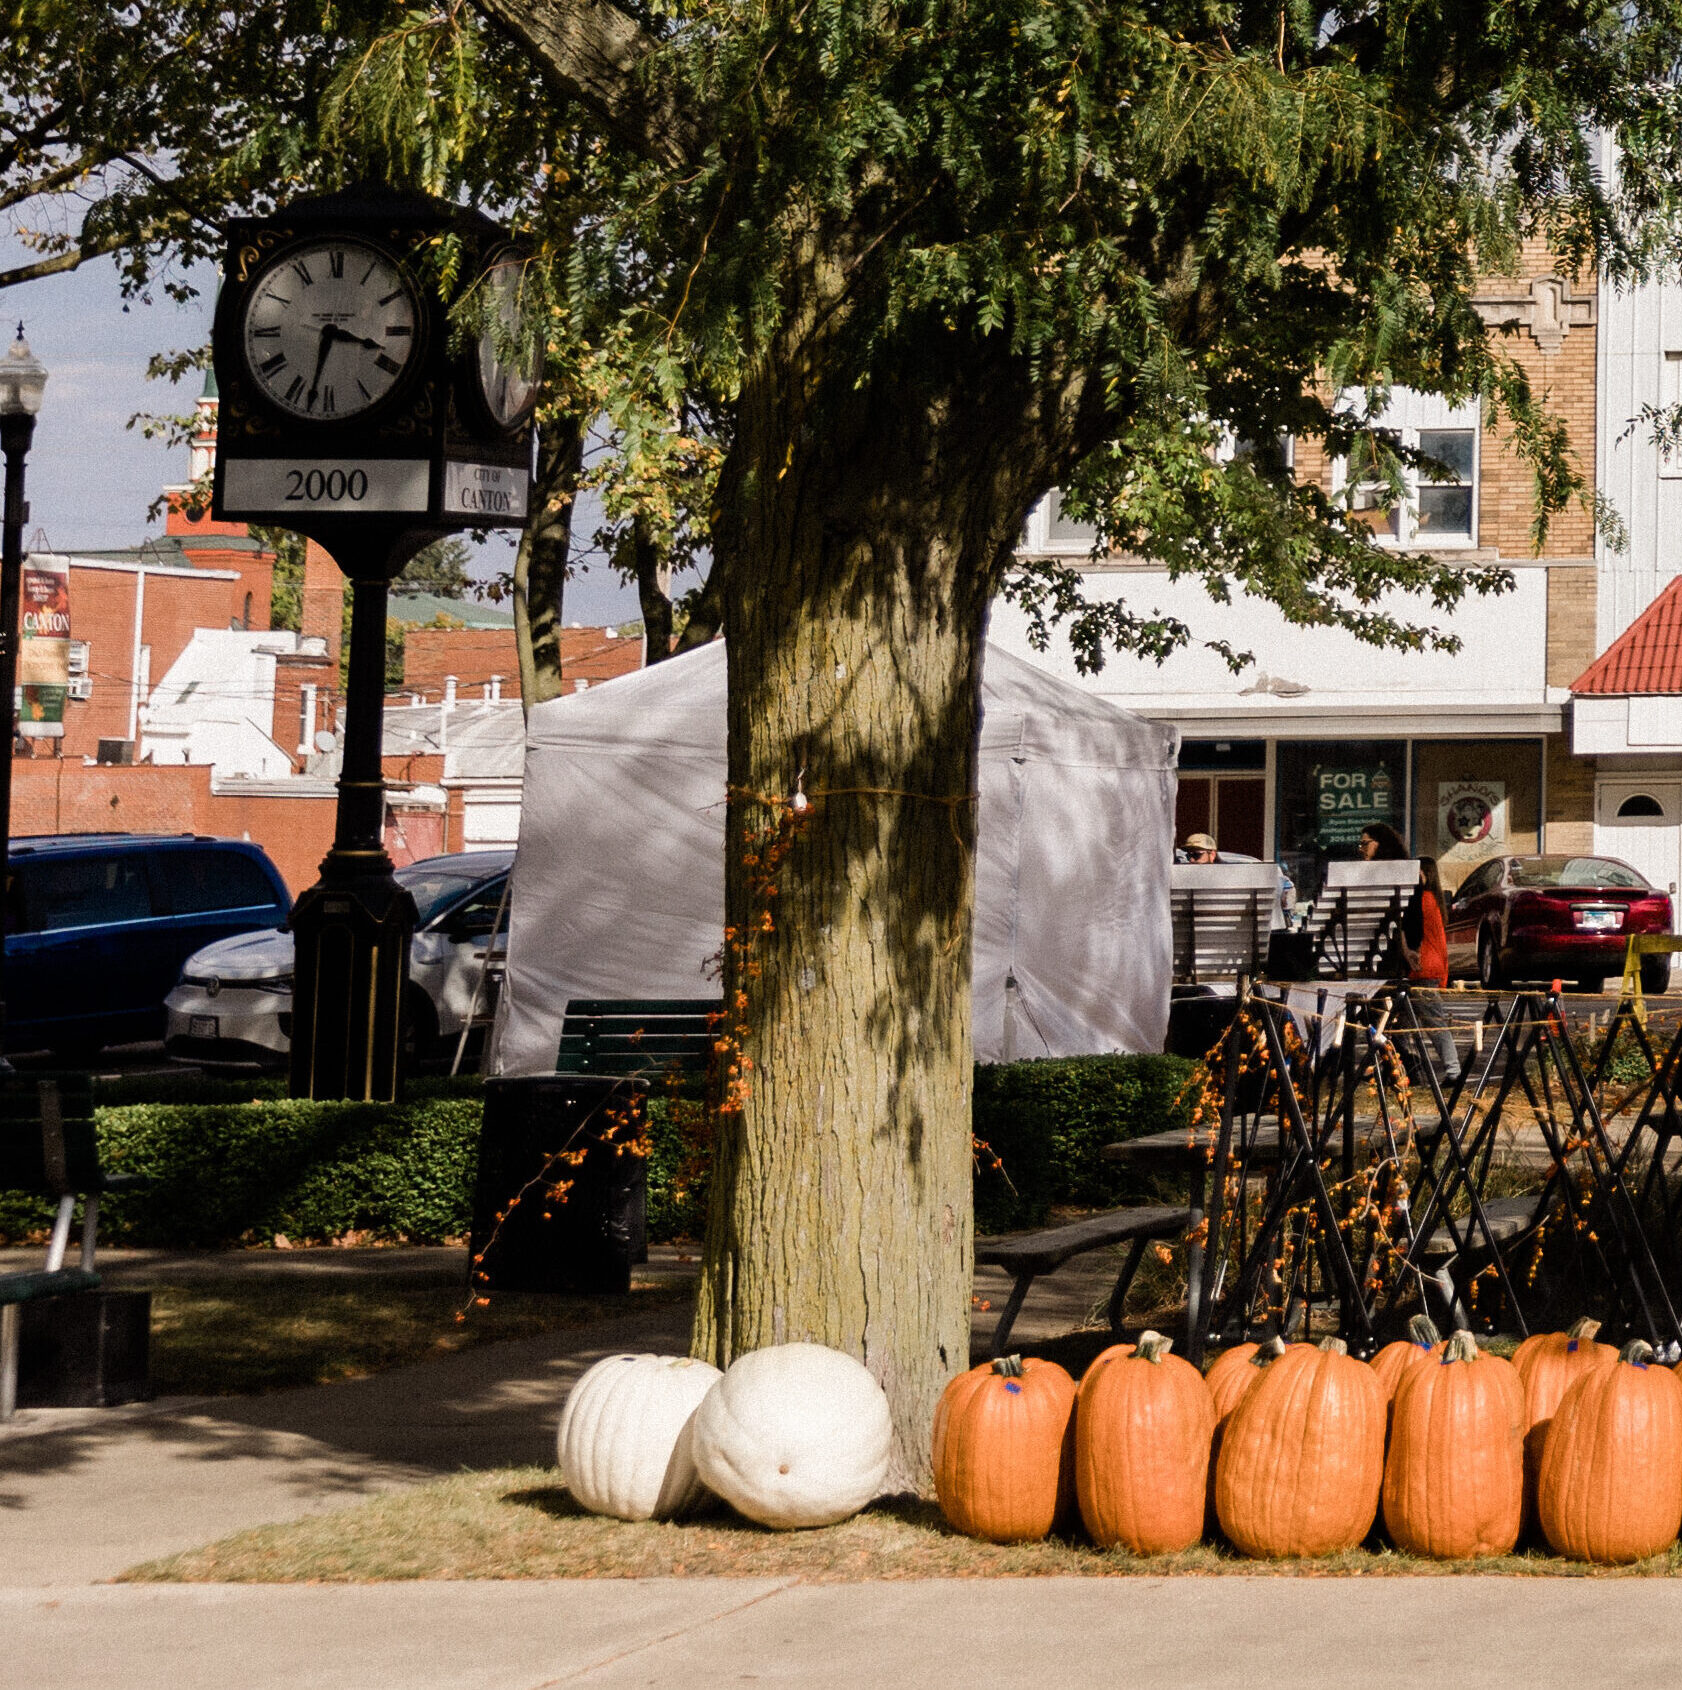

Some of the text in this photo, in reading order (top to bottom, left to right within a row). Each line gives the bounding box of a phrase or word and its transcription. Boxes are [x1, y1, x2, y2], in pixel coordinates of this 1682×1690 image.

[285, 469, 368, 501] 2000
[461, 487, 513, 512] CANTON
[24, 610, 70, 632] CANTON
[1320, 773, 1367, 789] FOR
[1320, 792, 1388, 810] SALE
